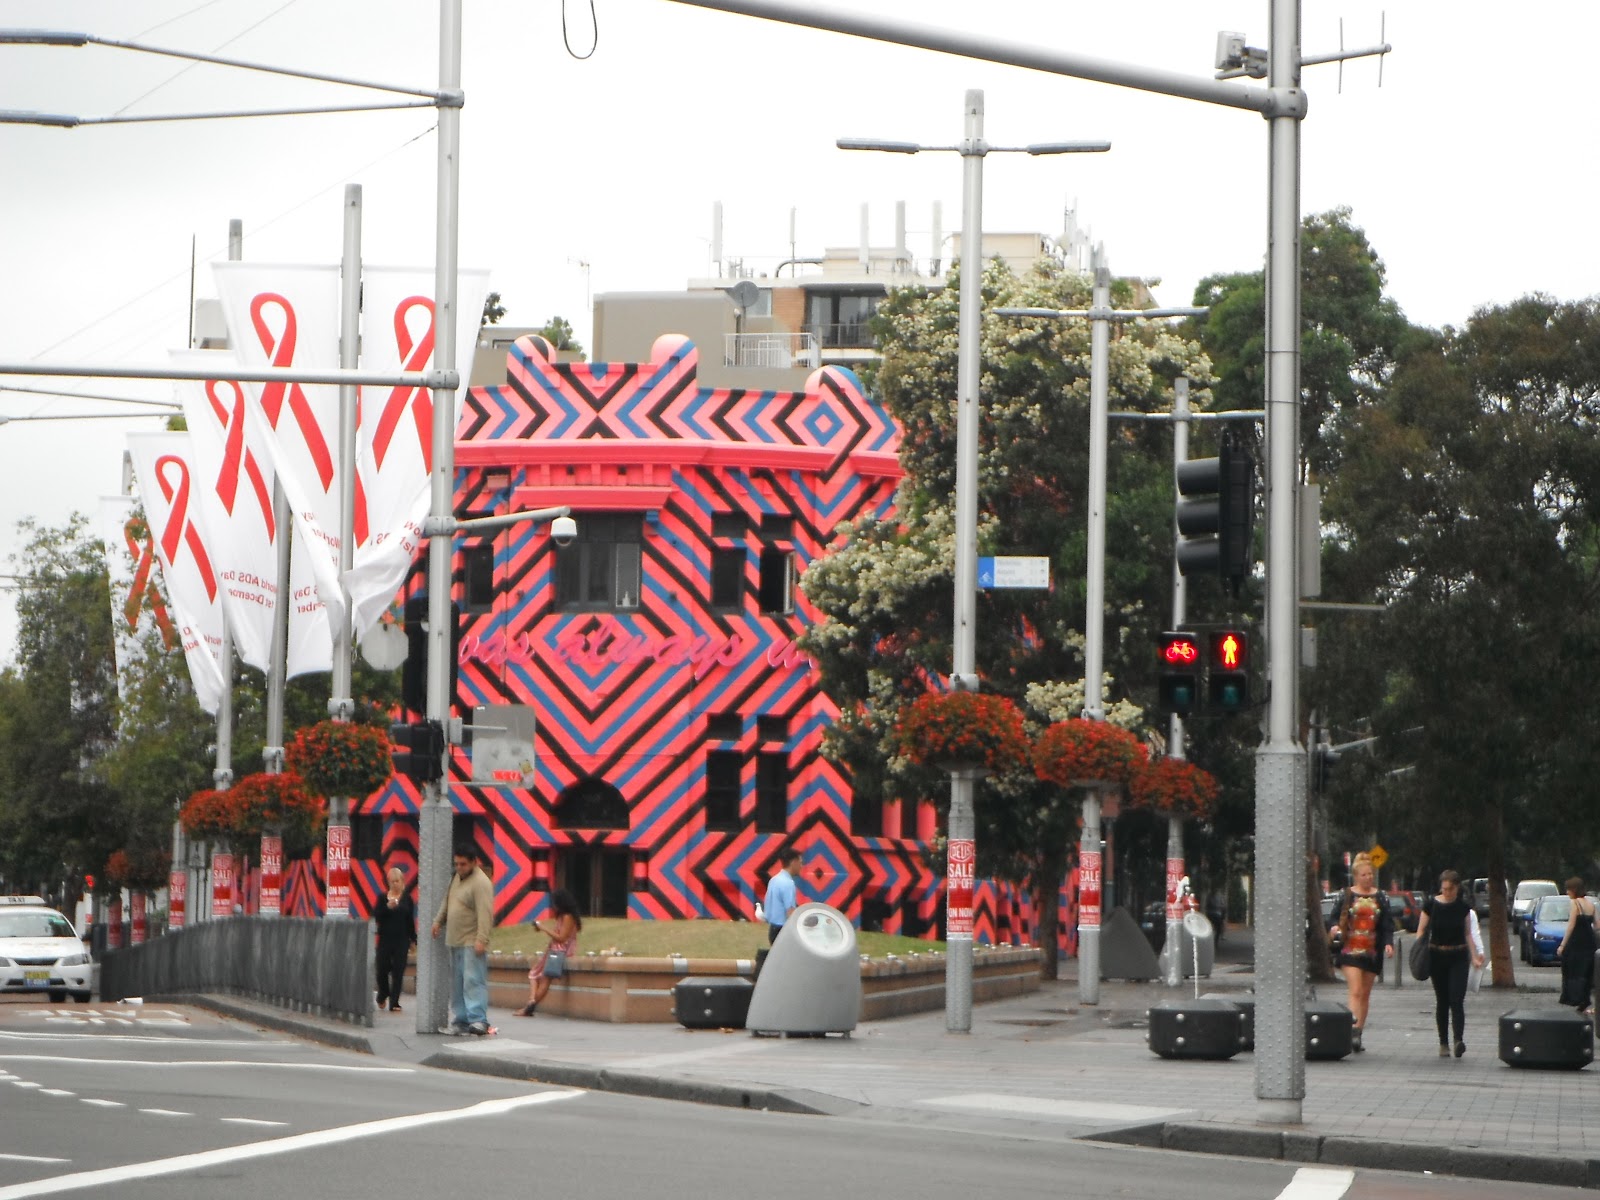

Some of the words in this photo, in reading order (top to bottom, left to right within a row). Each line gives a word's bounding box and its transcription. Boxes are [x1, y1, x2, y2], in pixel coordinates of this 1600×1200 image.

[552, 621, 743, 681] always
[329, 847, 350, 859] SALE
[262, 855, 280, 865] SALE
[949, 863, 974, 878] SALE
[1080, 870, 1099, 881] SALE
[949, 908, 957, 917] ON
